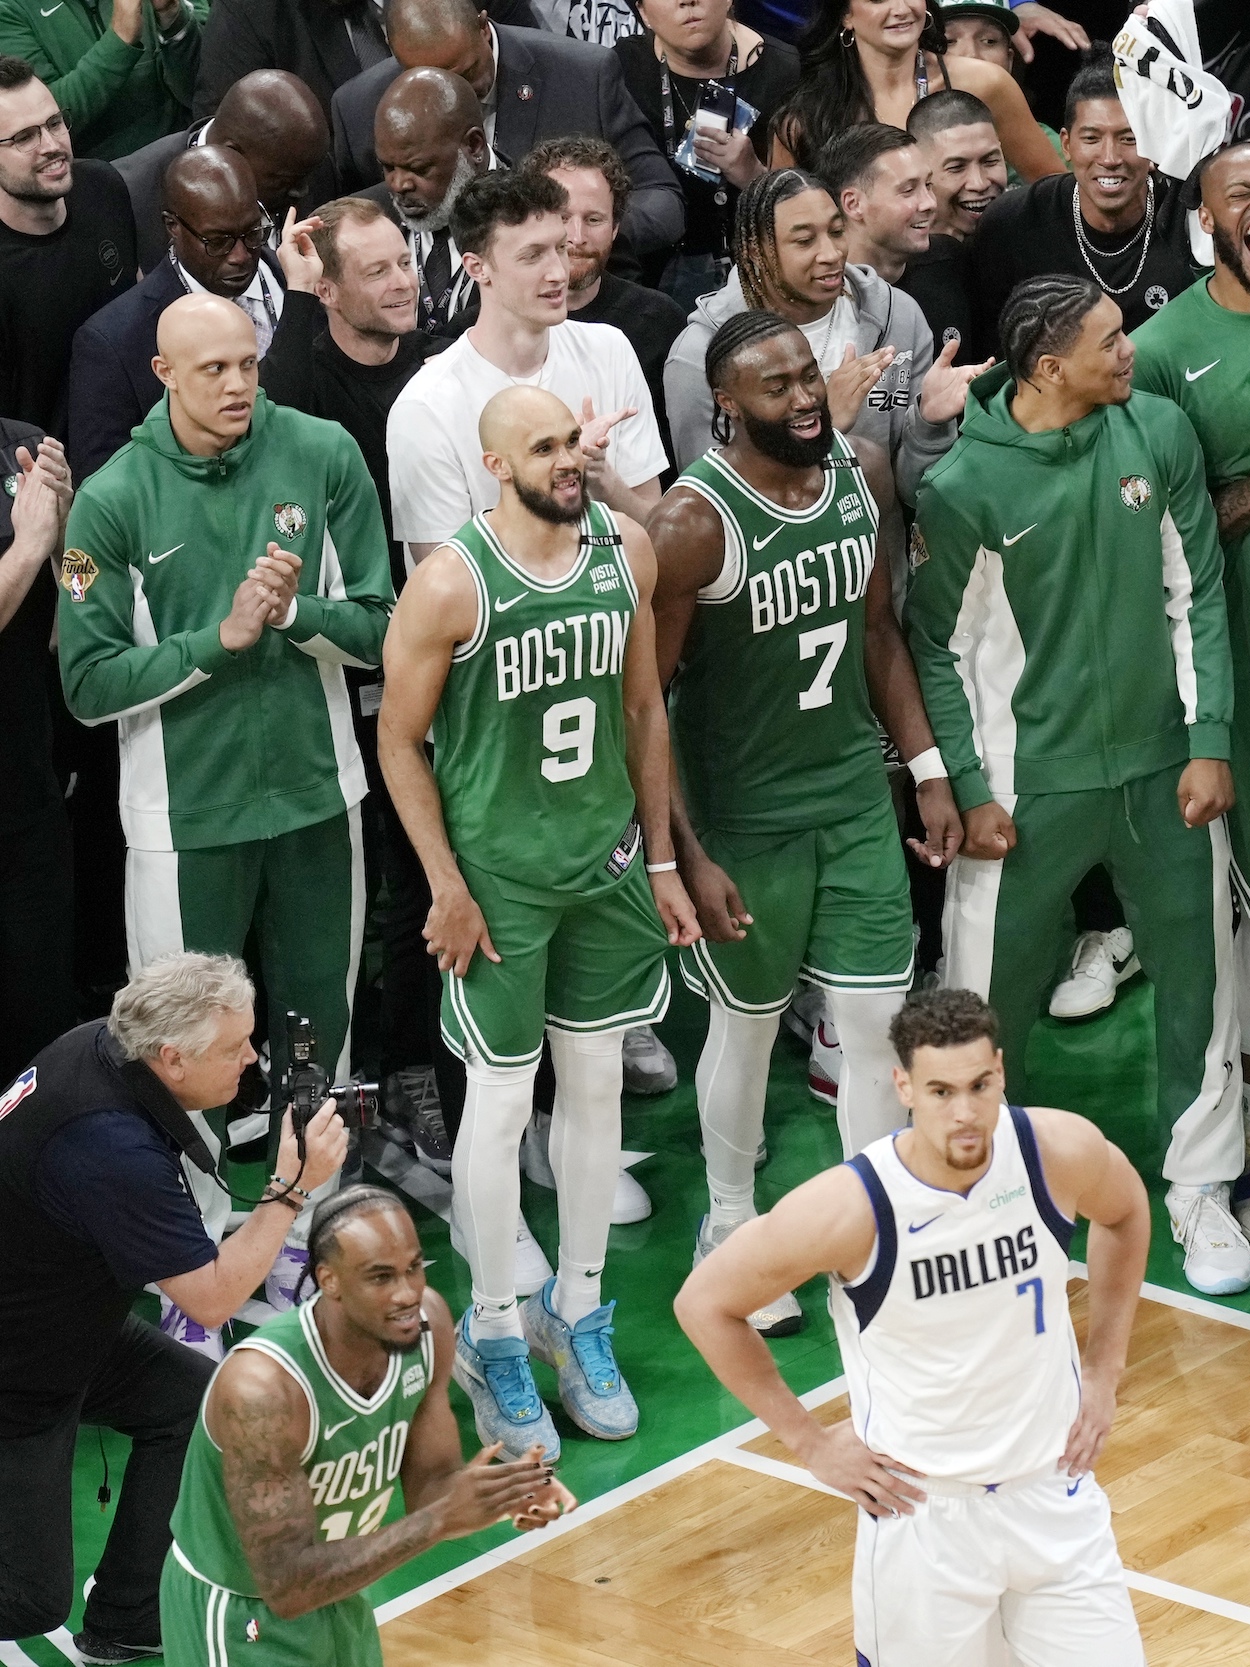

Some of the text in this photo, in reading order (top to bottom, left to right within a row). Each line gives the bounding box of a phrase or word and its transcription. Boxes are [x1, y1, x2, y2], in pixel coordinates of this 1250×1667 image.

[836, 493, 861, 514] VISTA
[841, 506, 863, 525] PRINT
[588, 537, 615, 545] WALTON
[589, 564, 618, 582] VISTA
[593, 577, 620, 594] PRINT
[749, 533, 876, 634] BOSTON
[495, 611, 629, 701] BOSTON
[799, 619, 848, 711] 7
[541, 696, 596, 783] 9
[989, 1186, 1026, 1208] chime
[910, 1224, 1038, 1299] DALLAS
[1016, 1277, 1046, 1335] 7
